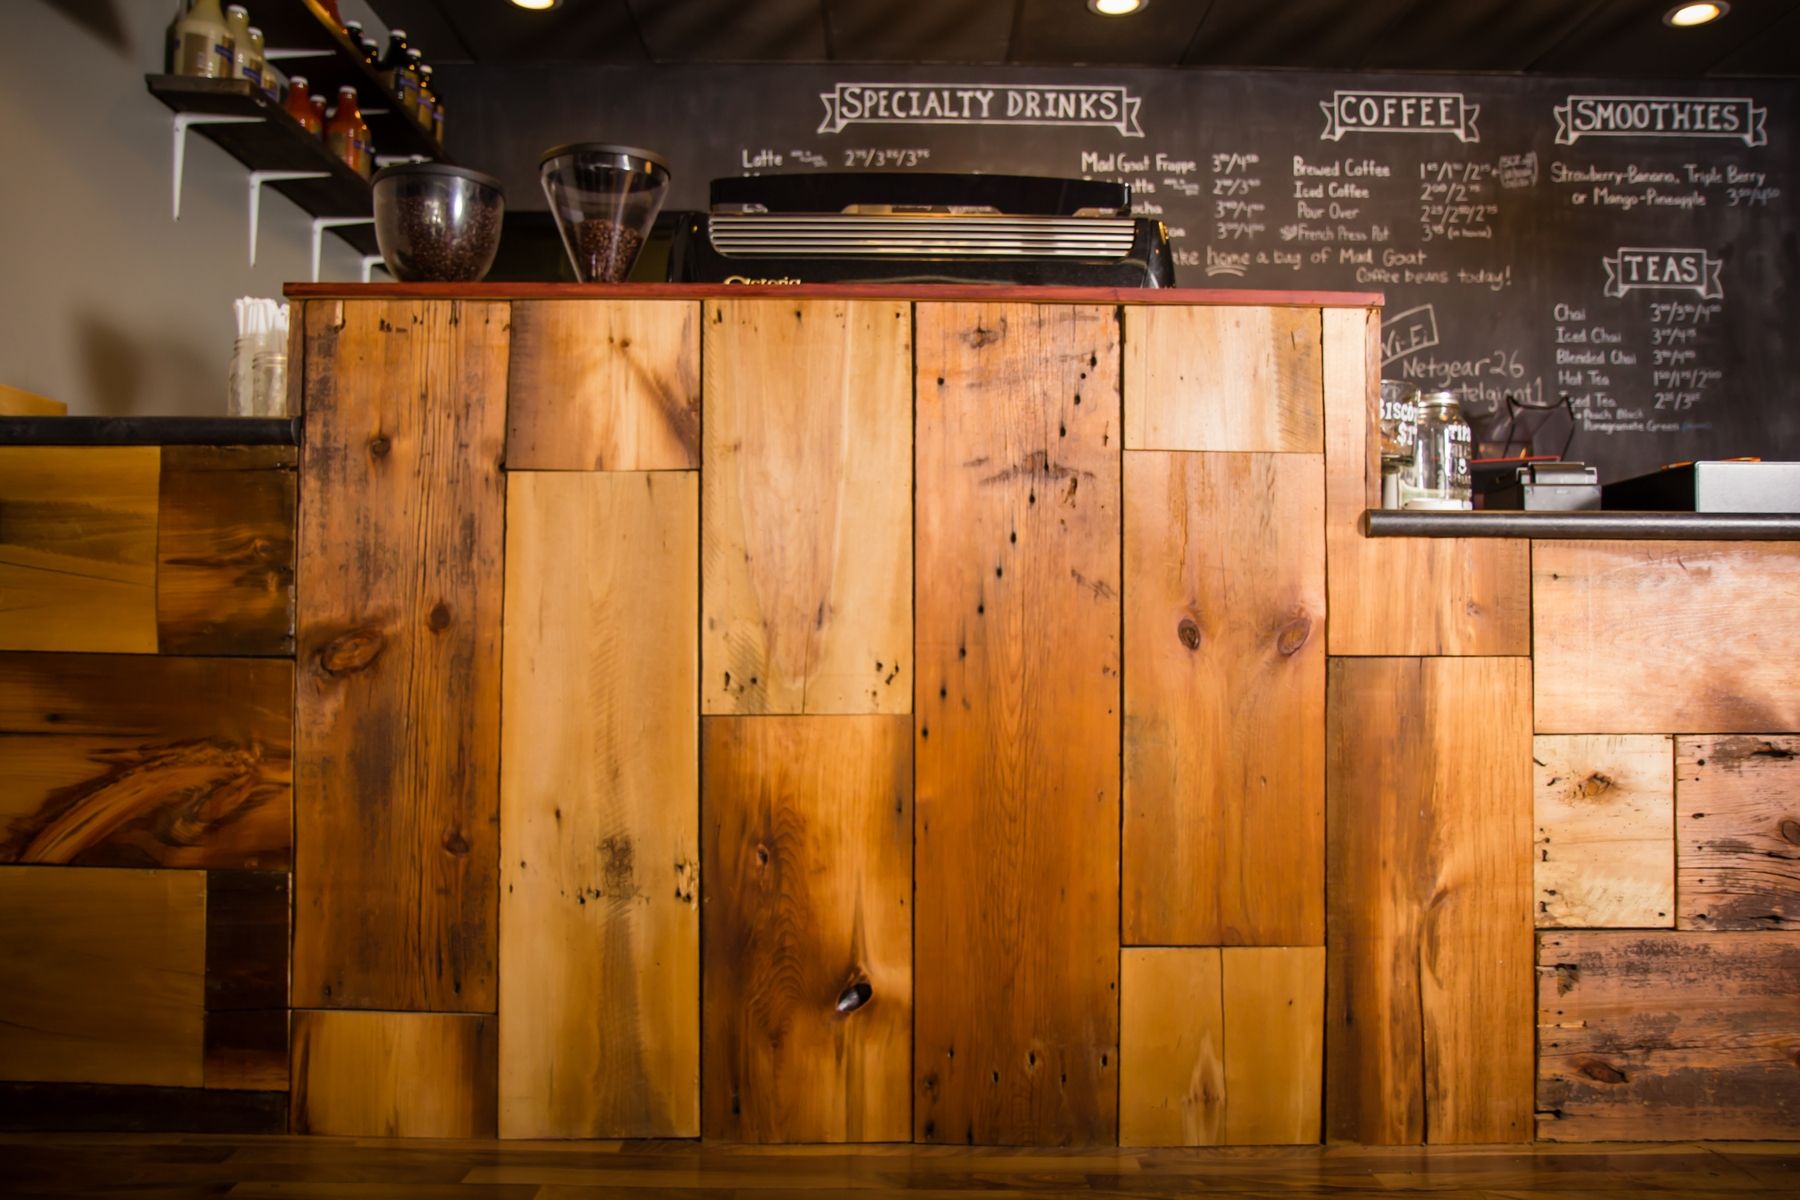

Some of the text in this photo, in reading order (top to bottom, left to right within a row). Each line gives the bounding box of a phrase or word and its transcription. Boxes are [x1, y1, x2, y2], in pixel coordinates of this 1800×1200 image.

[841, 88, 1119, 120] SPECIALTY DRINKS
[1340, 96, 1456, 127] COFFEE
[1574, 100, 1739, 131] SMOOTHIES
[742, 149, 783, 168] Latte
[1081, 151, 1115, 173] Mad
[1117, 153, 1150, 173] Goat
[1156, 154, 1197, 175] Frappe
[1293, 155, 1340, 177] Brewed
[1345, 158, 1390, 177] Coffee
[1683, 163, 1723, 187] Triple
[1727, 165, 1766, 186] Berry
[1293, 181, 1324, 198] Iced
[1328, 182, 1369, 198] Coffee
[1571, 191, 1587, 205] or
[1297, 200, 1325, 219] Pour
[1328, 202, 1360, 219] Over
[1298, 222, 1334, 240] French
[1338, 225, 1367, 240] Press
[1372, 225, 1390, 241] Pot
[1172, 246, 1427, 270] ake home a bag of Mad Goat
[1356, 265, 1512, 291] Coffee beans today!
[1623, 255, 1698, 282] TEAS
[1554, 303, 1586, 321] Chai
[1555, 327, 1587, 343] Iced
[1591, 327, 1622, 343] Chai
[1556, 348, 1605, 364] Blended
[1610, 349, 1637, 364] Chai
[1558, 369, 1582, 385] Hot
[1587, 370, 1610, 386] Tea
[1595, 392, 1617, 407] Tea
[1646, 420, 1680, 432] Green
